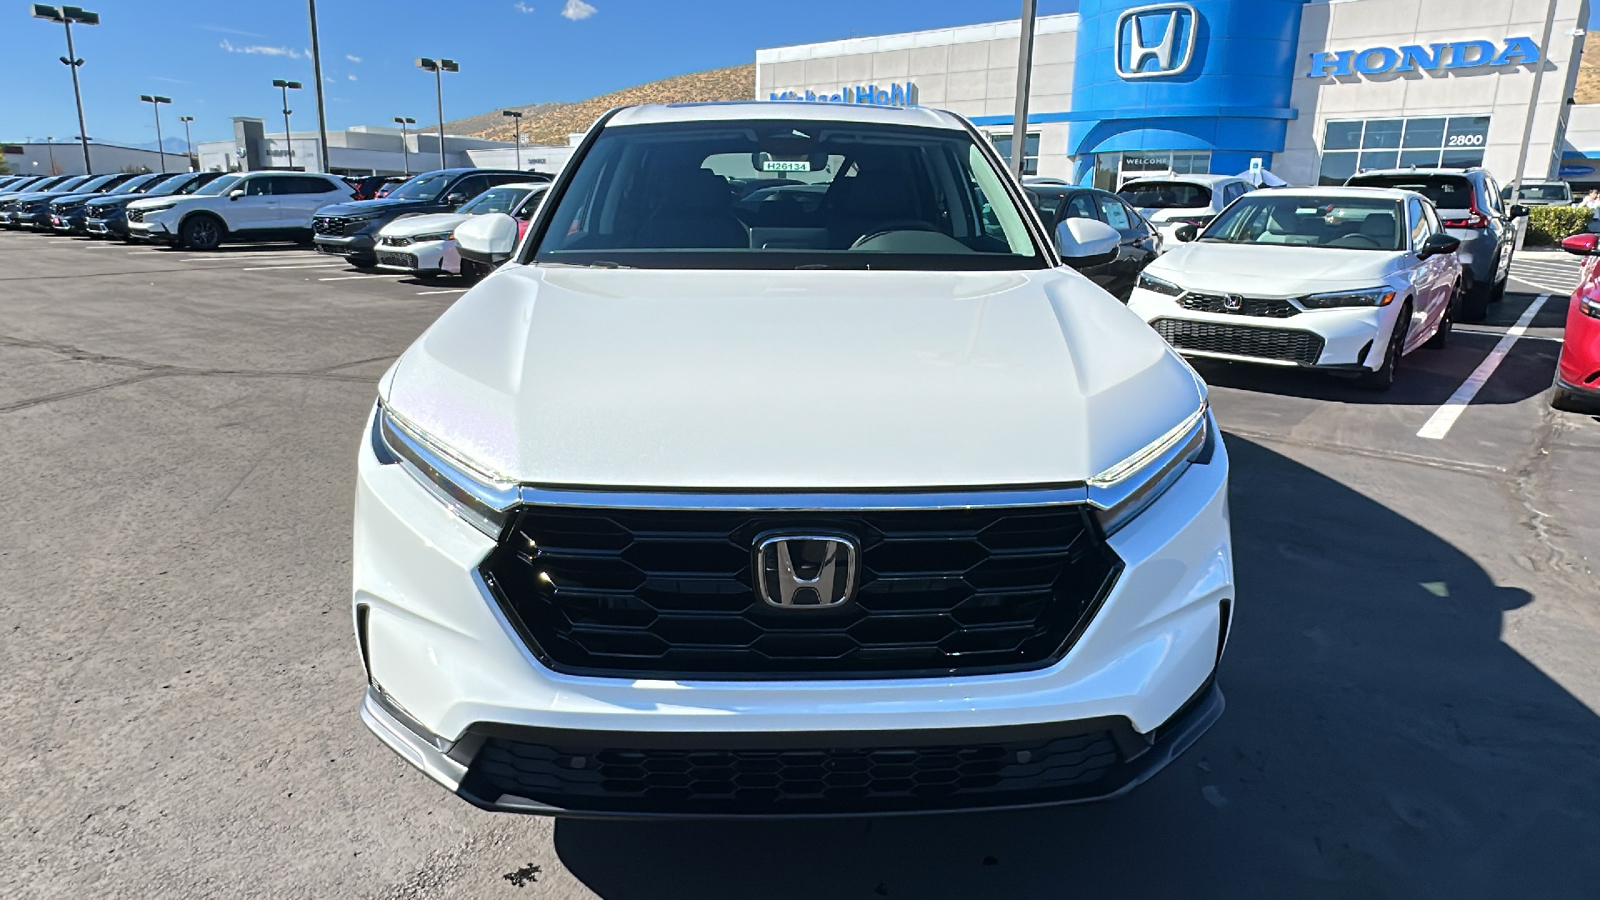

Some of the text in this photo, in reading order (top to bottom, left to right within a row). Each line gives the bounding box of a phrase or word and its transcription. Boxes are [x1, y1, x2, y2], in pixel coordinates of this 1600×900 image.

[1307, 36, 1541, 77] HONDA
[855, 81, 912, 106] Hohl
[1448, 134, 1483, 146] 2800
[767, 162, 806, 170] H26134
